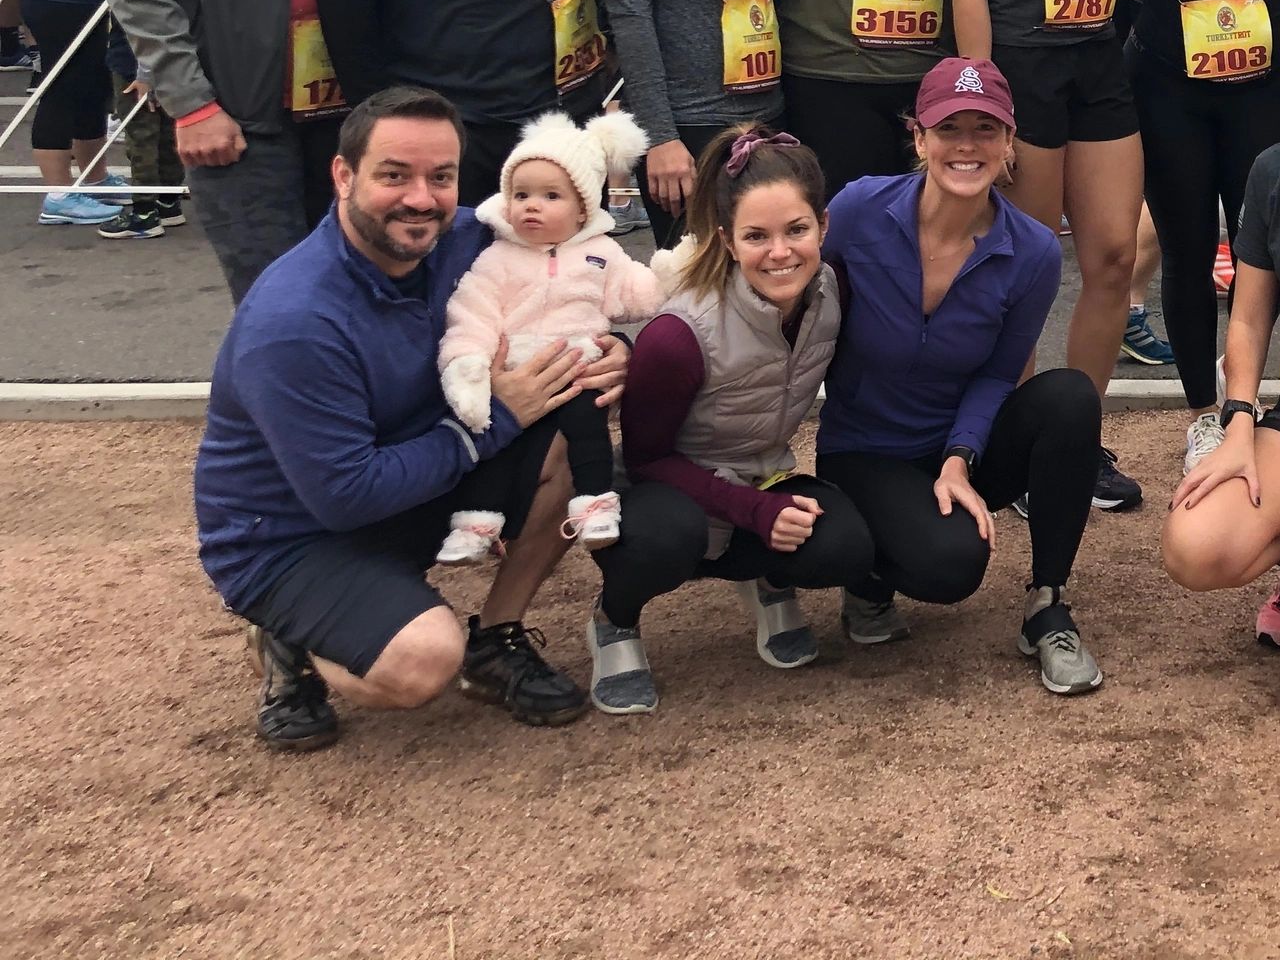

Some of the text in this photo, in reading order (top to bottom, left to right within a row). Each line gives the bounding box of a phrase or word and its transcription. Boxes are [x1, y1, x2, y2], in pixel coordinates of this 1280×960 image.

[856, 8, 938, 34] 3156
[741, 50, 776, 77] 107
[1191, 45, 1267, 76] 2103
